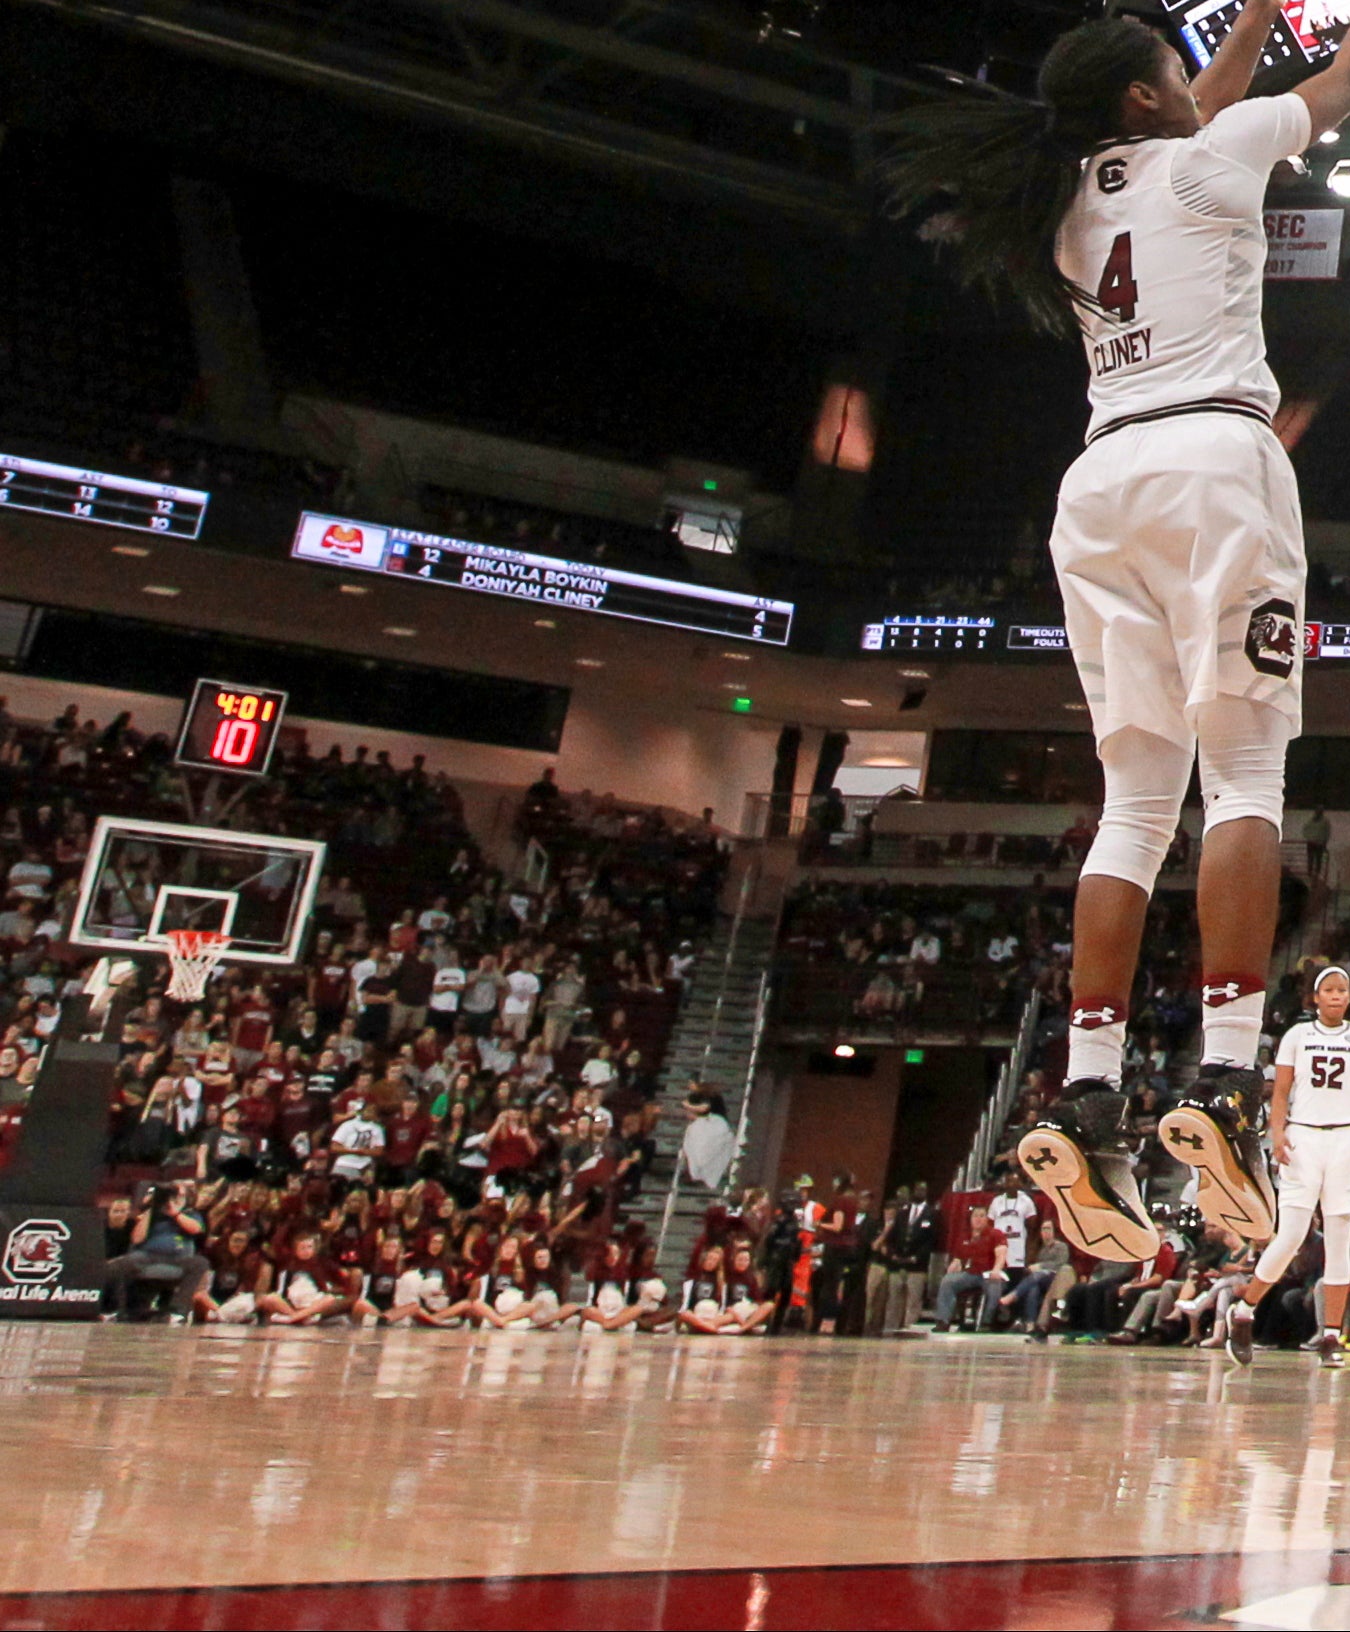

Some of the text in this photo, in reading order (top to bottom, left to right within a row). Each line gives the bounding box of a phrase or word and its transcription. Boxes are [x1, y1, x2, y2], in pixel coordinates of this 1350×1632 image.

[1097, 231, 1138, 323] 4
[1094, 328, 1152, 376] CLINEY
[74, 503, 169, 530] 14 10
[157, 500, 174, 514] 12
[418, 565, 763, 638] 4 DONIYAH CLINEY 5
[423, 548, 766, 624] 12 MIKAYLA BOYKIN 4
[1034, 638, 1064, 647] FOULS
[216, 691, 273, 722] 4:01
[210, 718, 260, 765] 10
[1311, 1056, 1345, 1089] 52
[20, 1284, 48, 1300] Life
[51, 1285, 100, 1302] Arena
